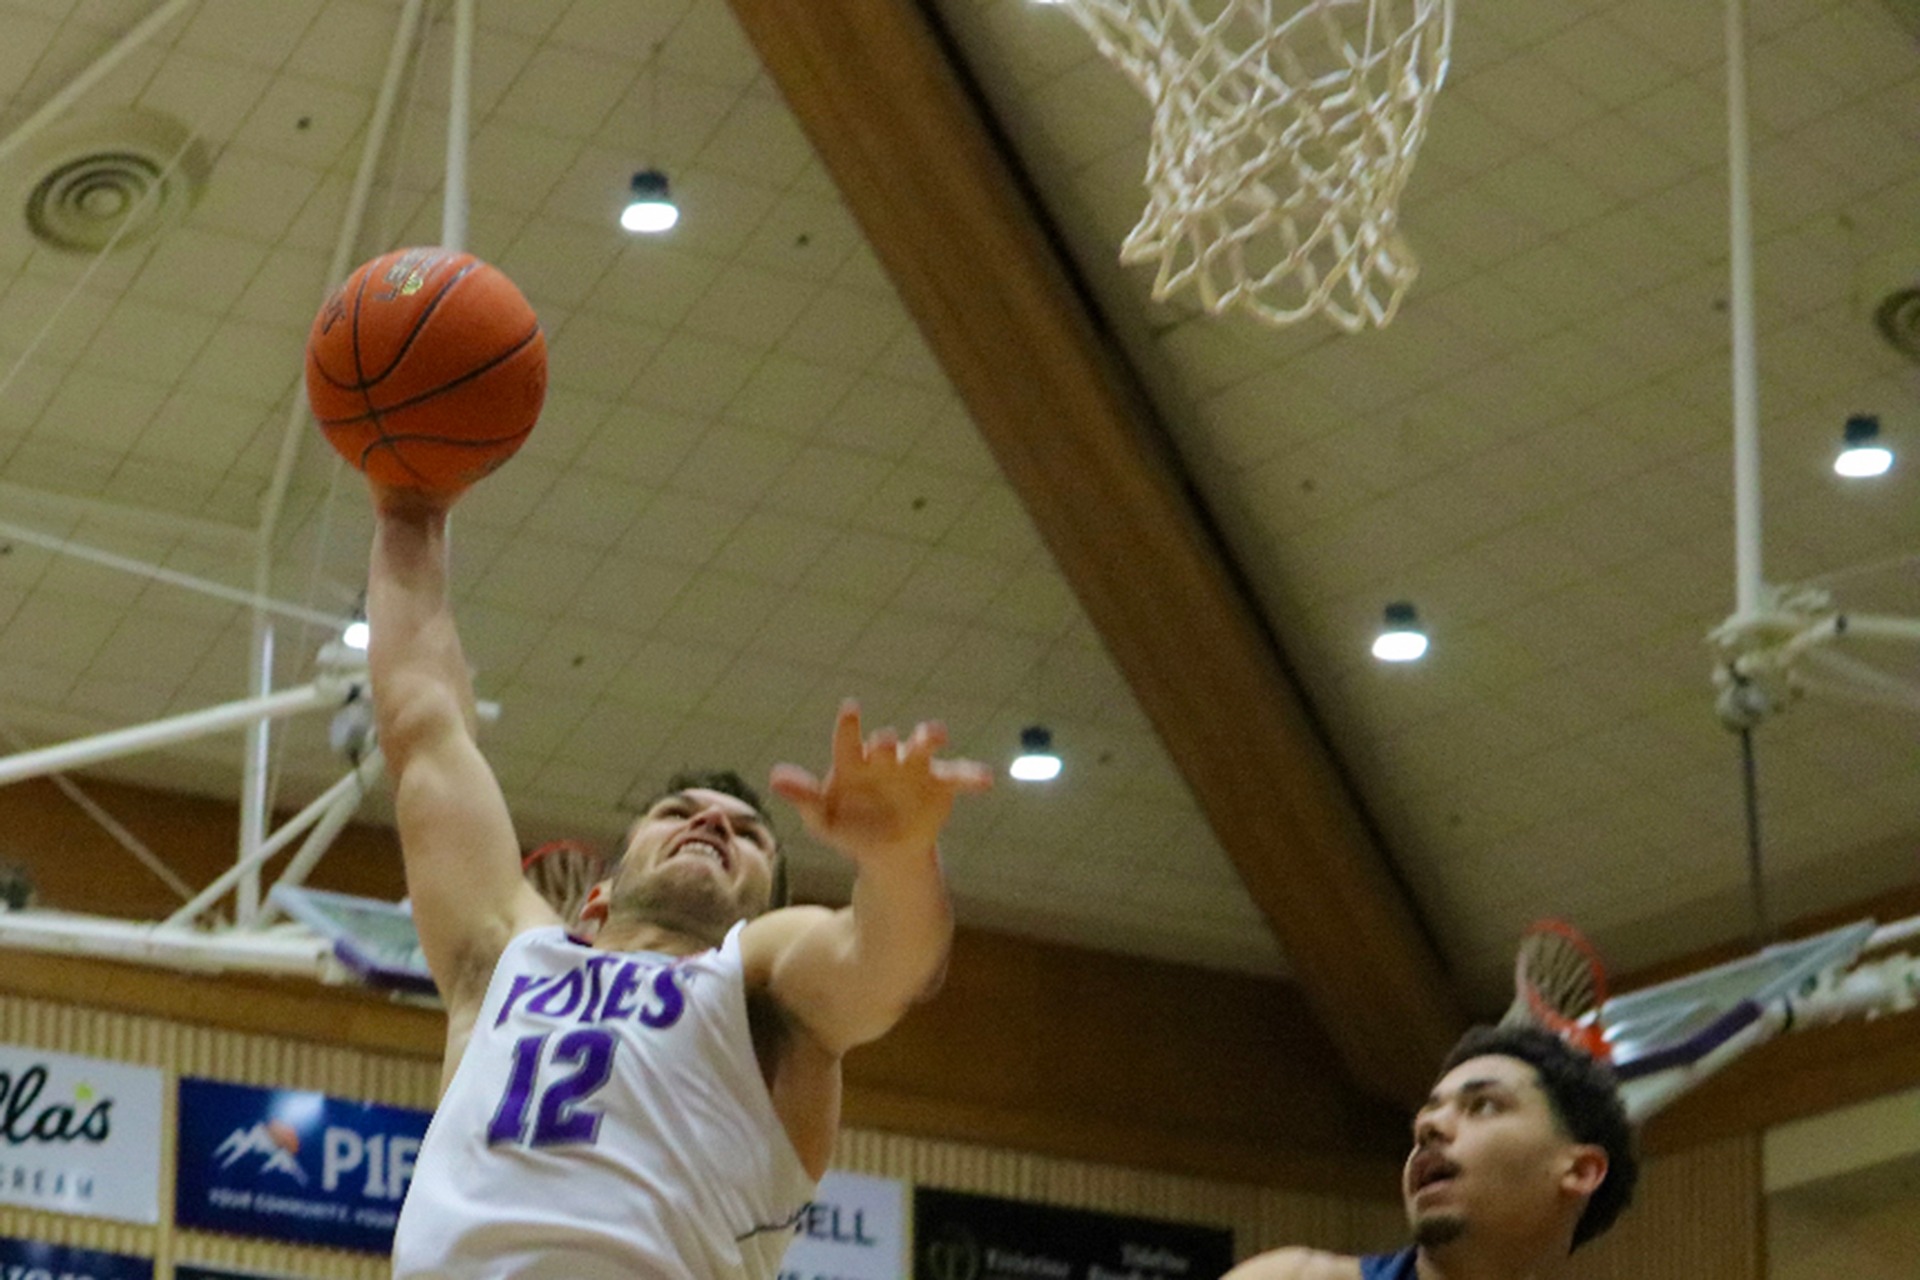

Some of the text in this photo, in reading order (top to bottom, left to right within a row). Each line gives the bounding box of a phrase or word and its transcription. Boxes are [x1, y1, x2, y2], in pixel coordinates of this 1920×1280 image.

[493, 955, 685, 1029] YOTES
[486, 1028, 620, 1149] 12
[795, 1202, 876, 1247] ELL
